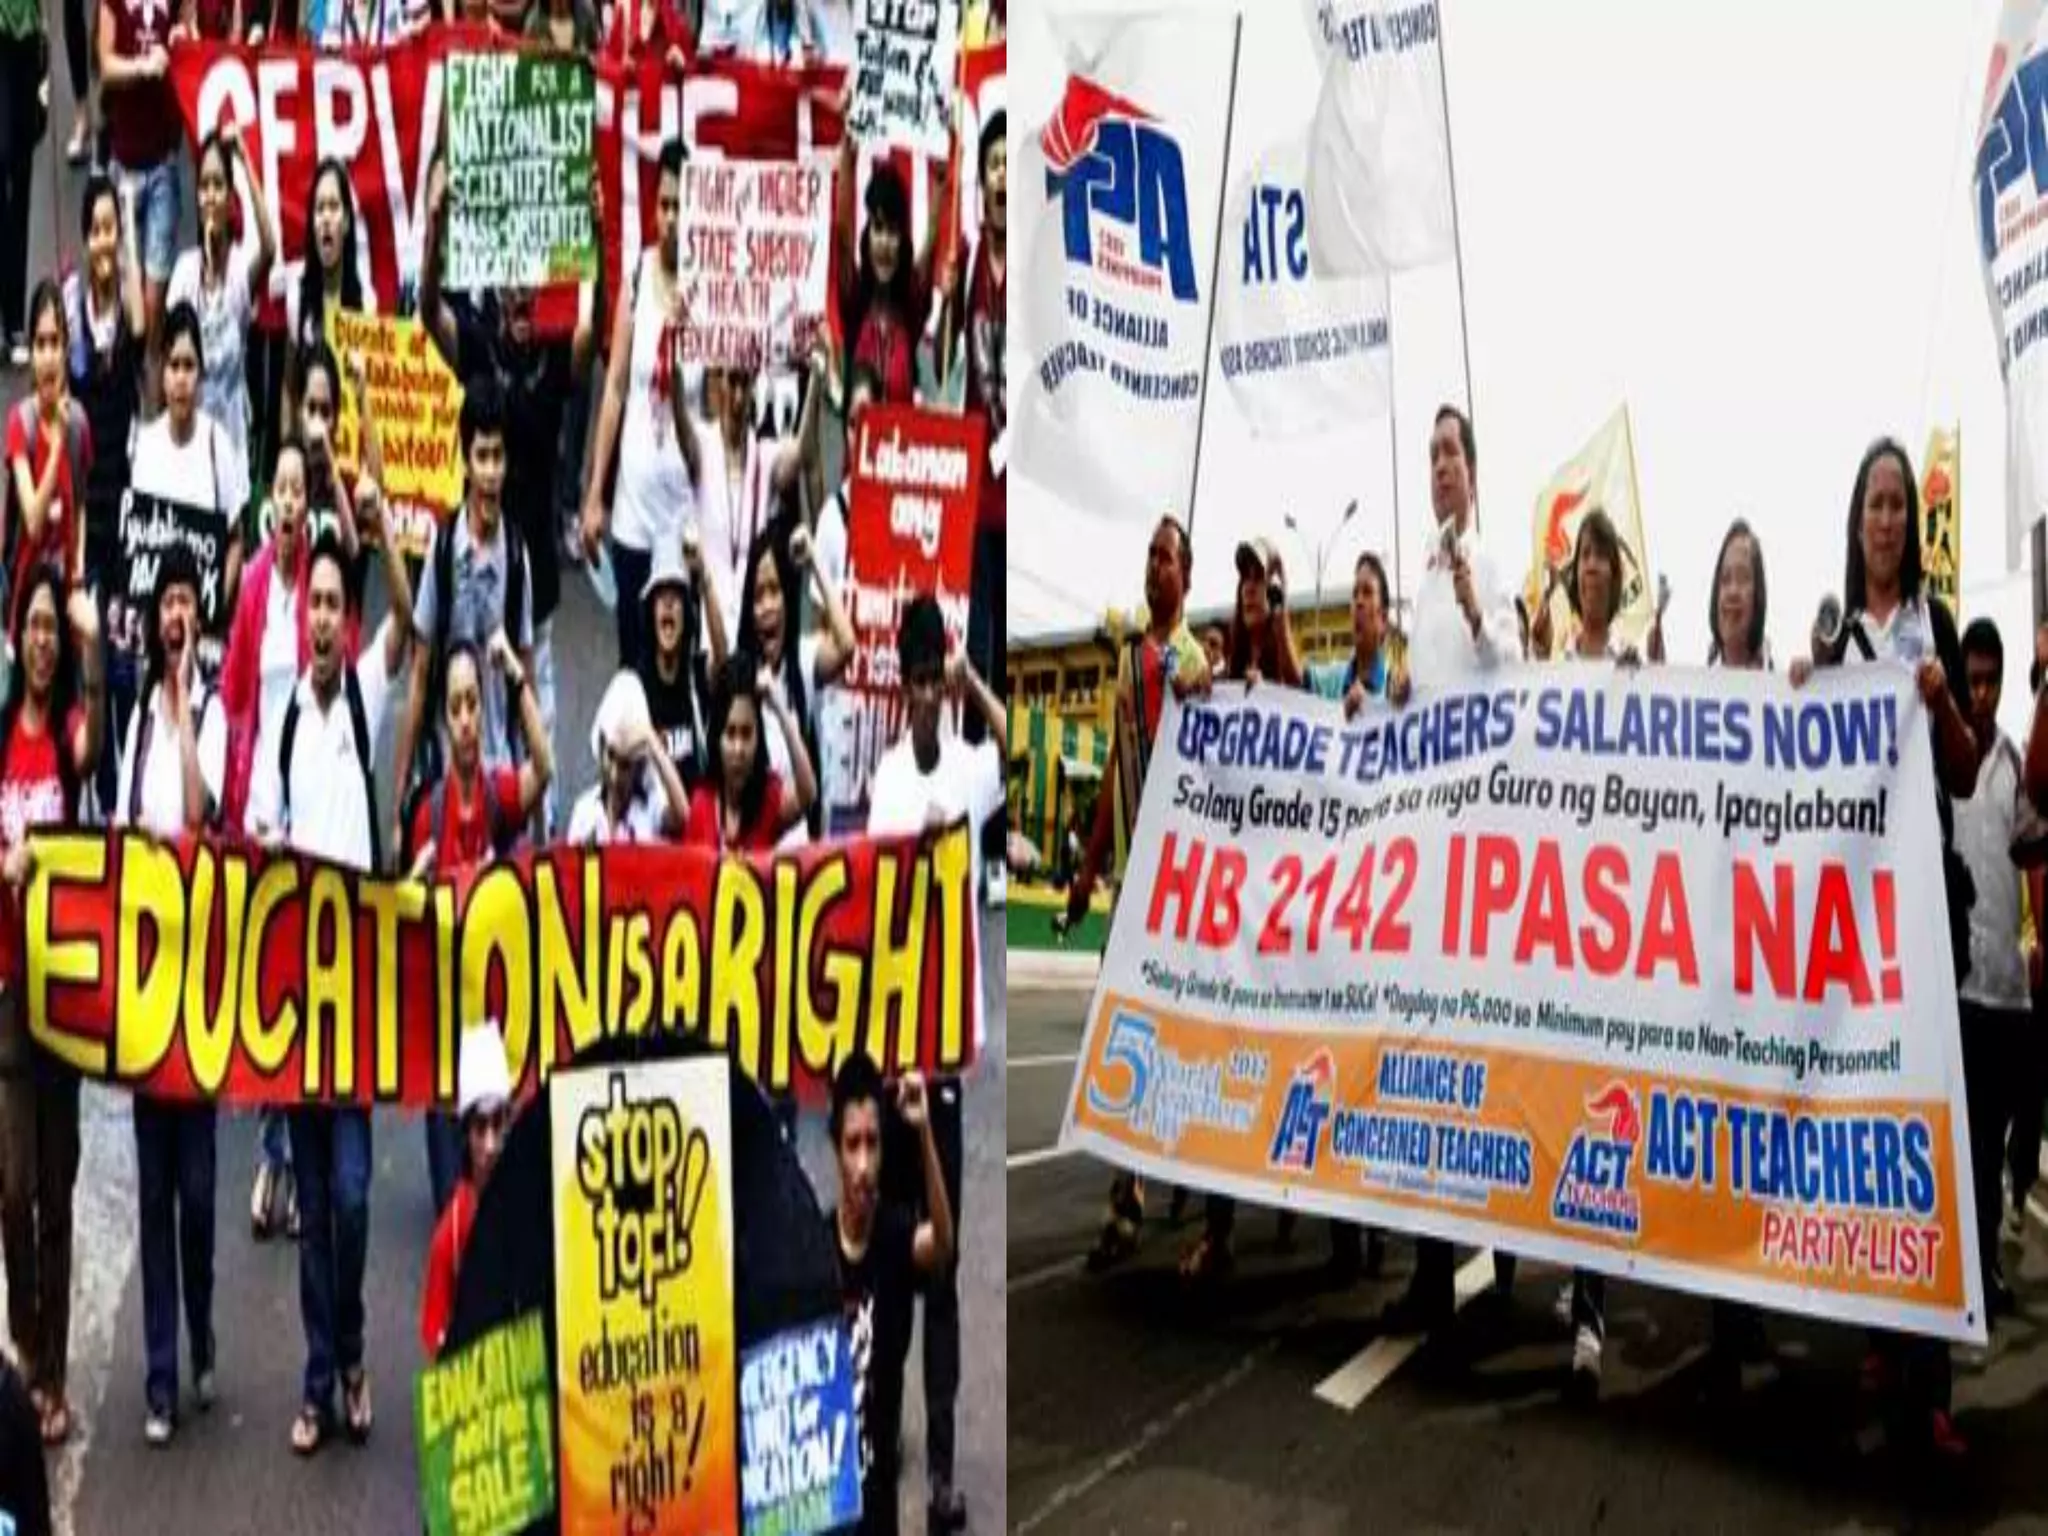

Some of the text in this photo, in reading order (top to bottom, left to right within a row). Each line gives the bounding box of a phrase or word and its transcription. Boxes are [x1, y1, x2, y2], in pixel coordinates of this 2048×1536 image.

[448, 53, 518, 109] FIGHT
[449, 102, 594, 164] NATIONALIST
[448, 159, 567, 209] SCIENTIFIC
[683, 225, 737, 273] STATE
[859, 421, 968, 493] Labanan
[891, 494, 942, 559] ang
[1177, 688, 1898, 781] UPGRADE TEACHERS' SALARIES NOW!
[1174, 773, 1244, 835] Salary
[1248, 789, 1312, 827] Grade
[1319, 799, 1341, 836] 15
[1394, 789, 1420, 812] sa
[1427, 777, 1480, 817] mga
[1488, 764, 1553, 807] Guro
[1561, 785, 1595, 826] ng
[1604, 774, 1705, 832] Bayan,
[1716, 782, 1887, 846] Ipaglaban!
[1146, 831, 1903, 1006] HB 2142 IPASA NA!
[24, 830, 602, 1098] EDUCATION
[609, 912, 651, 1032] IS
[661, 903, 704, 1031] A
[705, 824, 977, 1096] RIGHT
[1514, 1006, 1531, 1028] sa
[1537, 1001, 1604, 1037] Minimum
[1607, 1020, 1635, 1051] pay
[1637, 1020, 1673, 1054] para
[1676, 1026, 1695, 1050] sa
[1700, 1019, 1805, 1080] Non-Teaching
[1379, 1052, 1486, 1109] ALLIANCE OF
[576, 1071, 682, 1212] stop
[1333, 1111, 1531, 1185] CONCERNED TEACHERS
[1555, 1135, 1632, 1198] ACT
[1647, 1093, 1934, 1214] ACT TEACHERS
[1762, 1212, 1940, 1281] PARTY-LIST
[580, 1307, 701, 1396] education
[631, 1378, 655, 1441] is
[610, 1398, 706, 1517] right!
